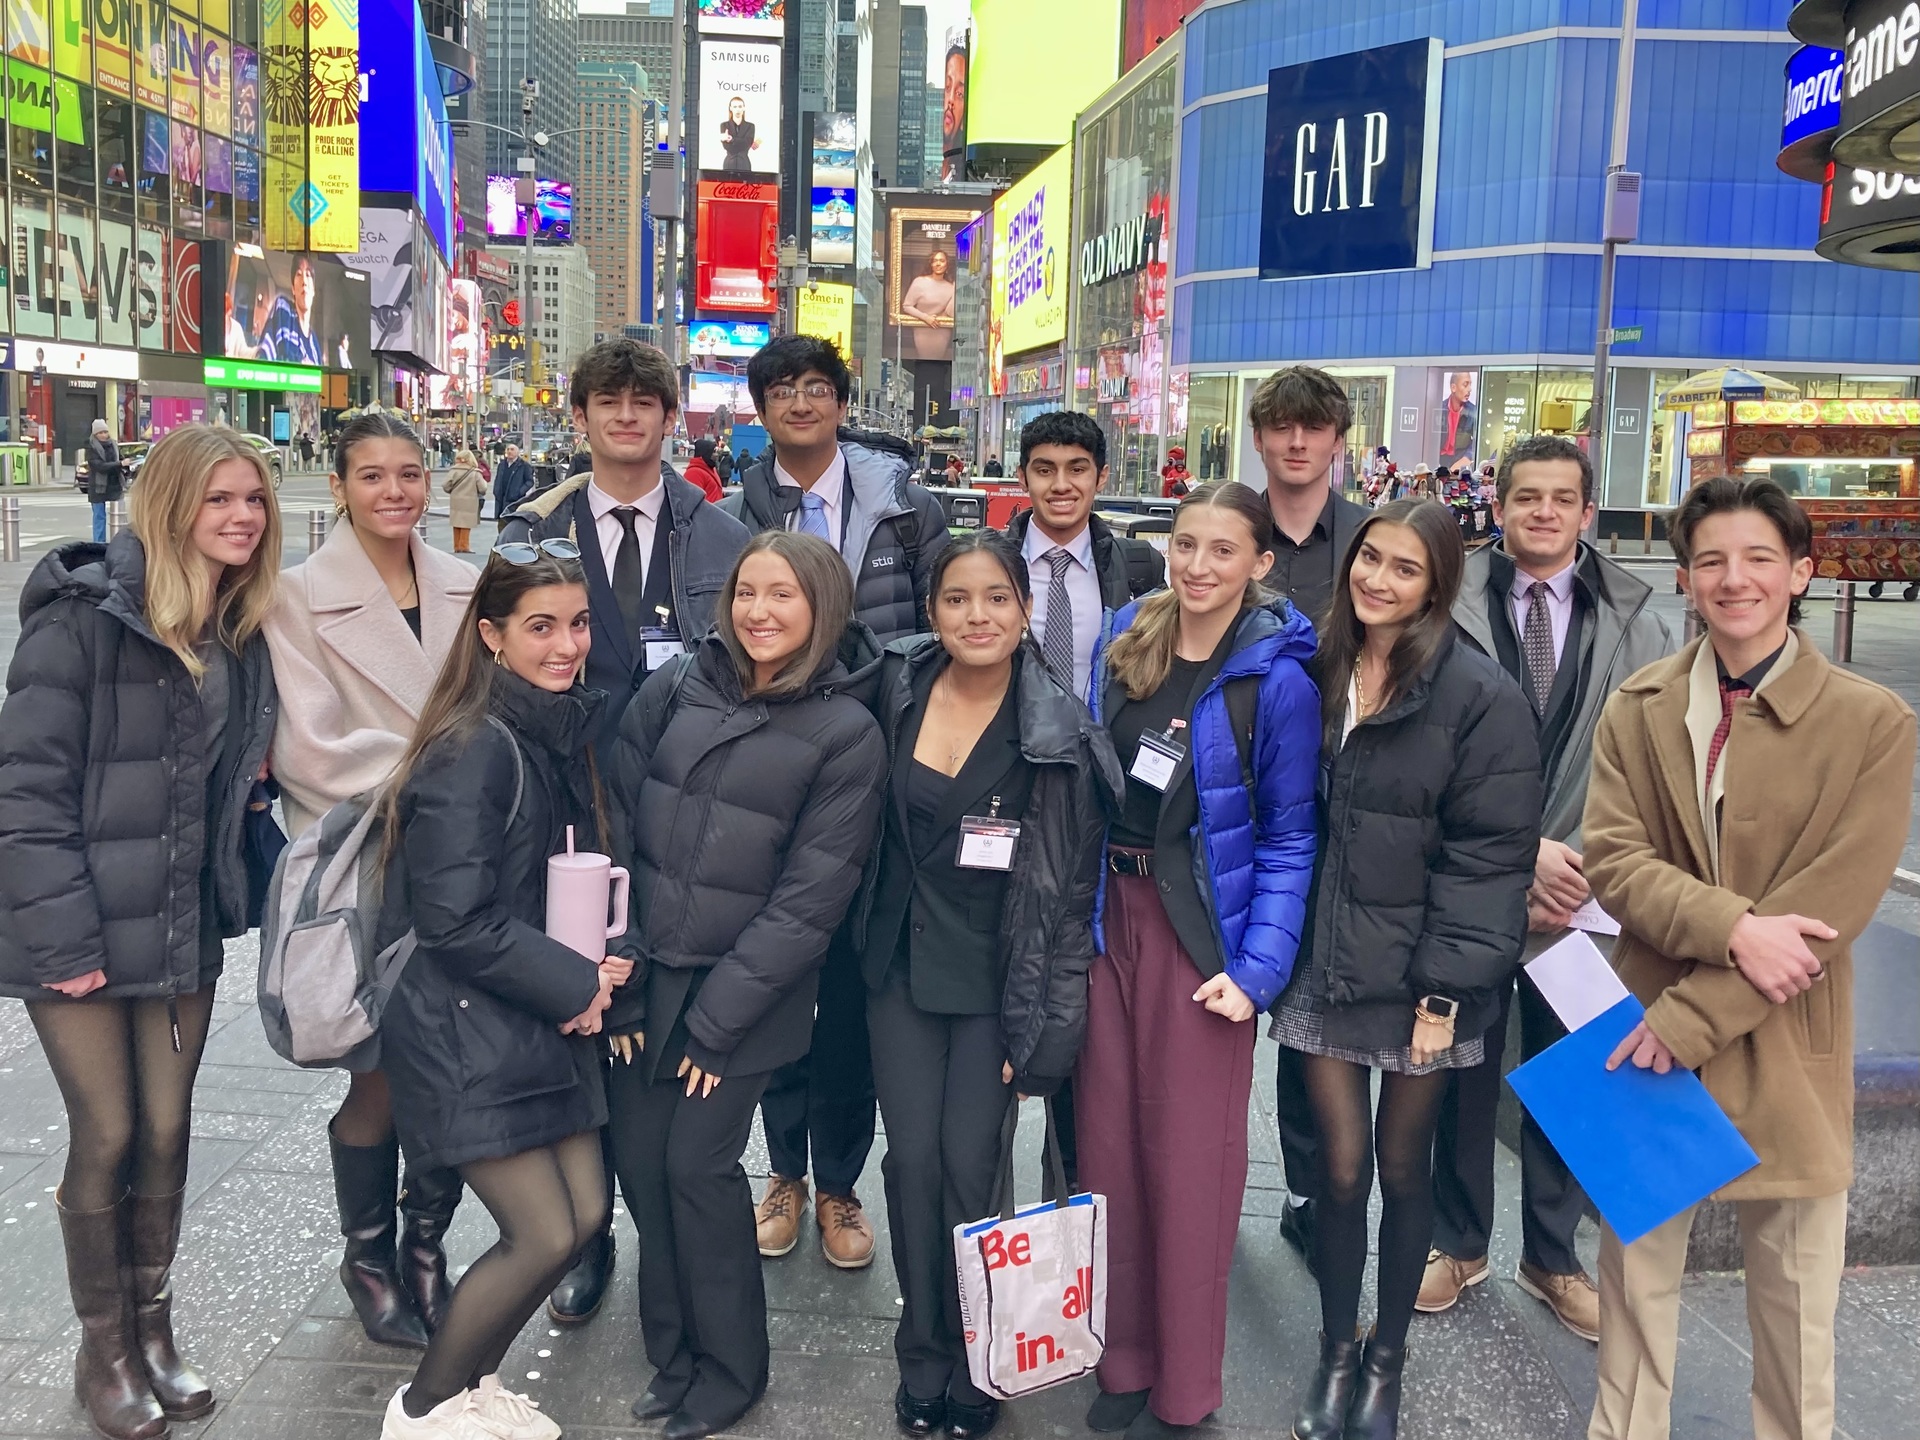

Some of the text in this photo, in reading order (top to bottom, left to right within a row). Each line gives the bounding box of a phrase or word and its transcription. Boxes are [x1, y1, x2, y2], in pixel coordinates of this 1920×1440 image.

[711, 51, 770, 64] SAMSUNG
[99, 71, 130, 91] ENTRANCE
[138, 87, 148, 99] ON
[717, 80, 767, 92] Yourself
[315, 135, 354, 146] PRIDE ROCK
[321, 145, 354, 156] CALLING
[1294, 112, 1388, 216] GAP
[1008, 185, 1045, 253] PRIVACY
[360, 231, 388, 243] EGA
[1015, 242, 1028, 274] FOR
[1029, 224, 1044, 260] THE
[1081, 212, 1147, 287] OLD NAVY
[348, 254, 389, 264] swatch
[1008, 255, 1043, 315] PEOPLE
[803, 293, 844, 304] come in
[1615, 328, 1642, 342] Broadway
[77, 380, 97, 388] TISSOT
[1669, 391, 1719, 403] SABRETT
[1504, 406, 1526, 414] BODY
[1619, 415, 1635, 427] GAP
[872, 556, 894, 568] stio
[982, 1230, 1032, 1271] Be
[957, 1266, 972, 1327] lululemon
[1062, 1266, 1092, 1319] all
[1015, 1332, 1064, 1373] in.
